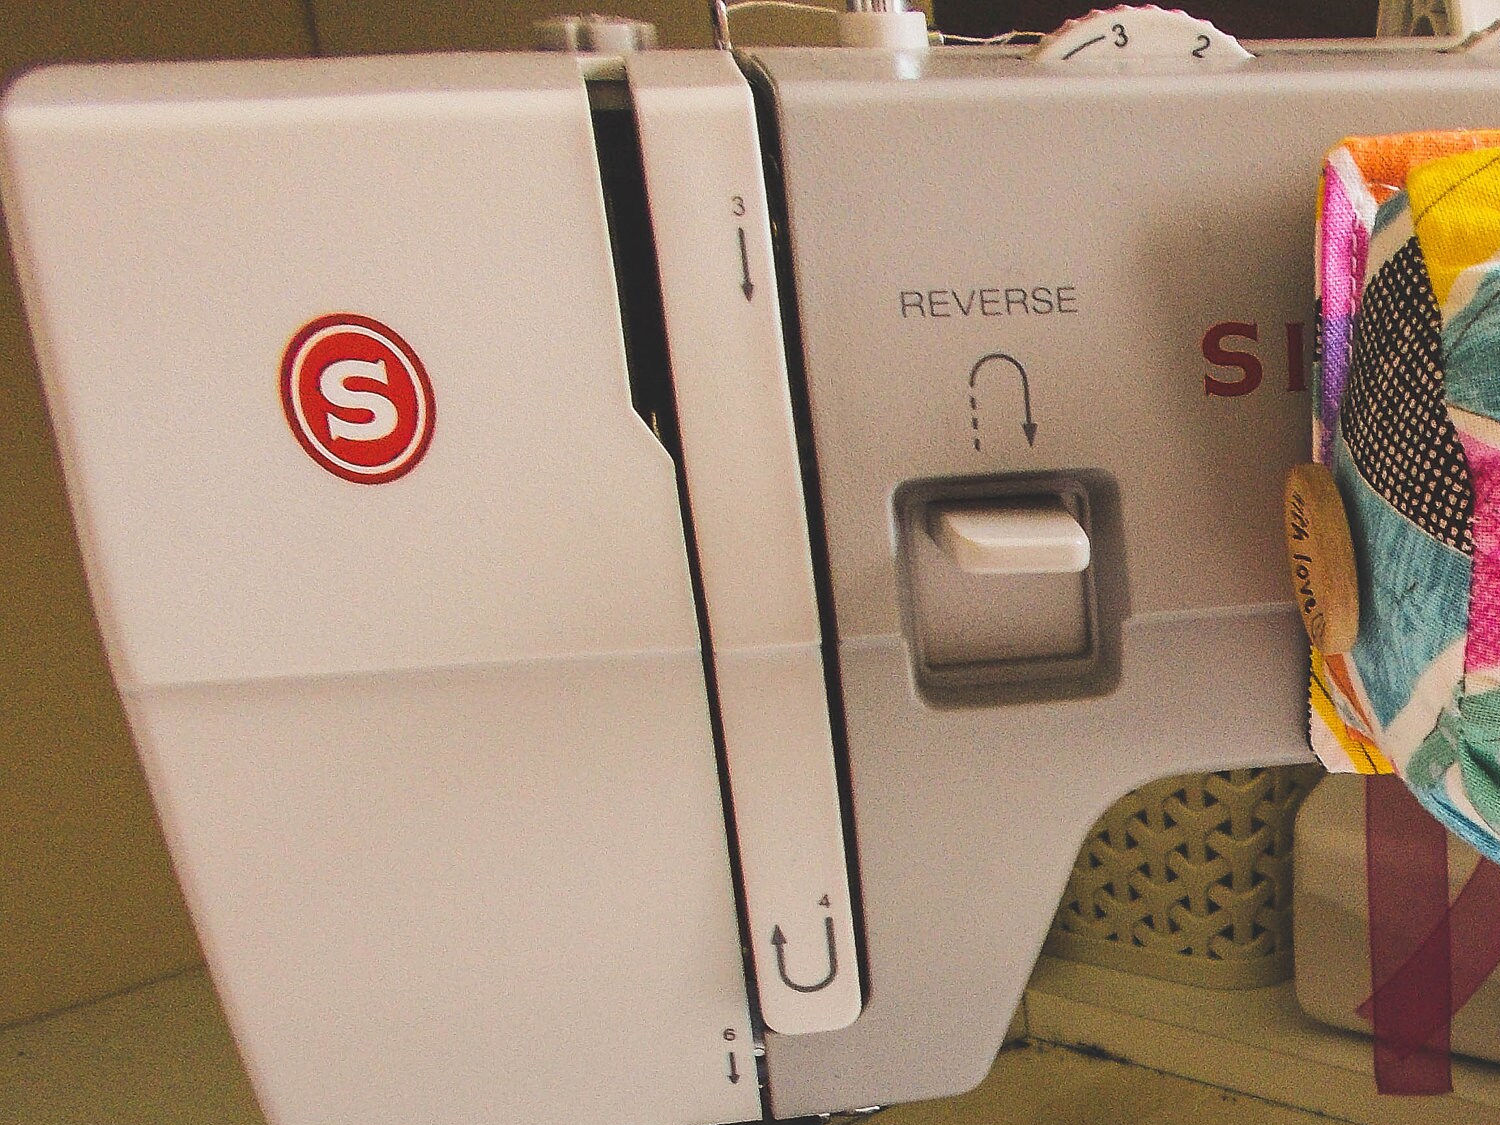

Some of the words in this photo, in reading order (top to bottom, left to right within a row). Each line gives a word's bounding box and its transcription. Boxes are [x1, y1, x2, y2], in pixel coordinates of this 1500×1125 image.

[1111, 23, 1129, 47] 3
[1192, 34, 1211, 58] 2
[731, 195, 746, 216] 3
[899, 285, 1079, 318] REVERSE
[1202, 320, 1308, 398] SI
[319, 358, 399, 441] S
[1292, 552, 1317, 615] love
[818, 894, 831, 909] 4
[722, 1028, 737, 1042] 6
